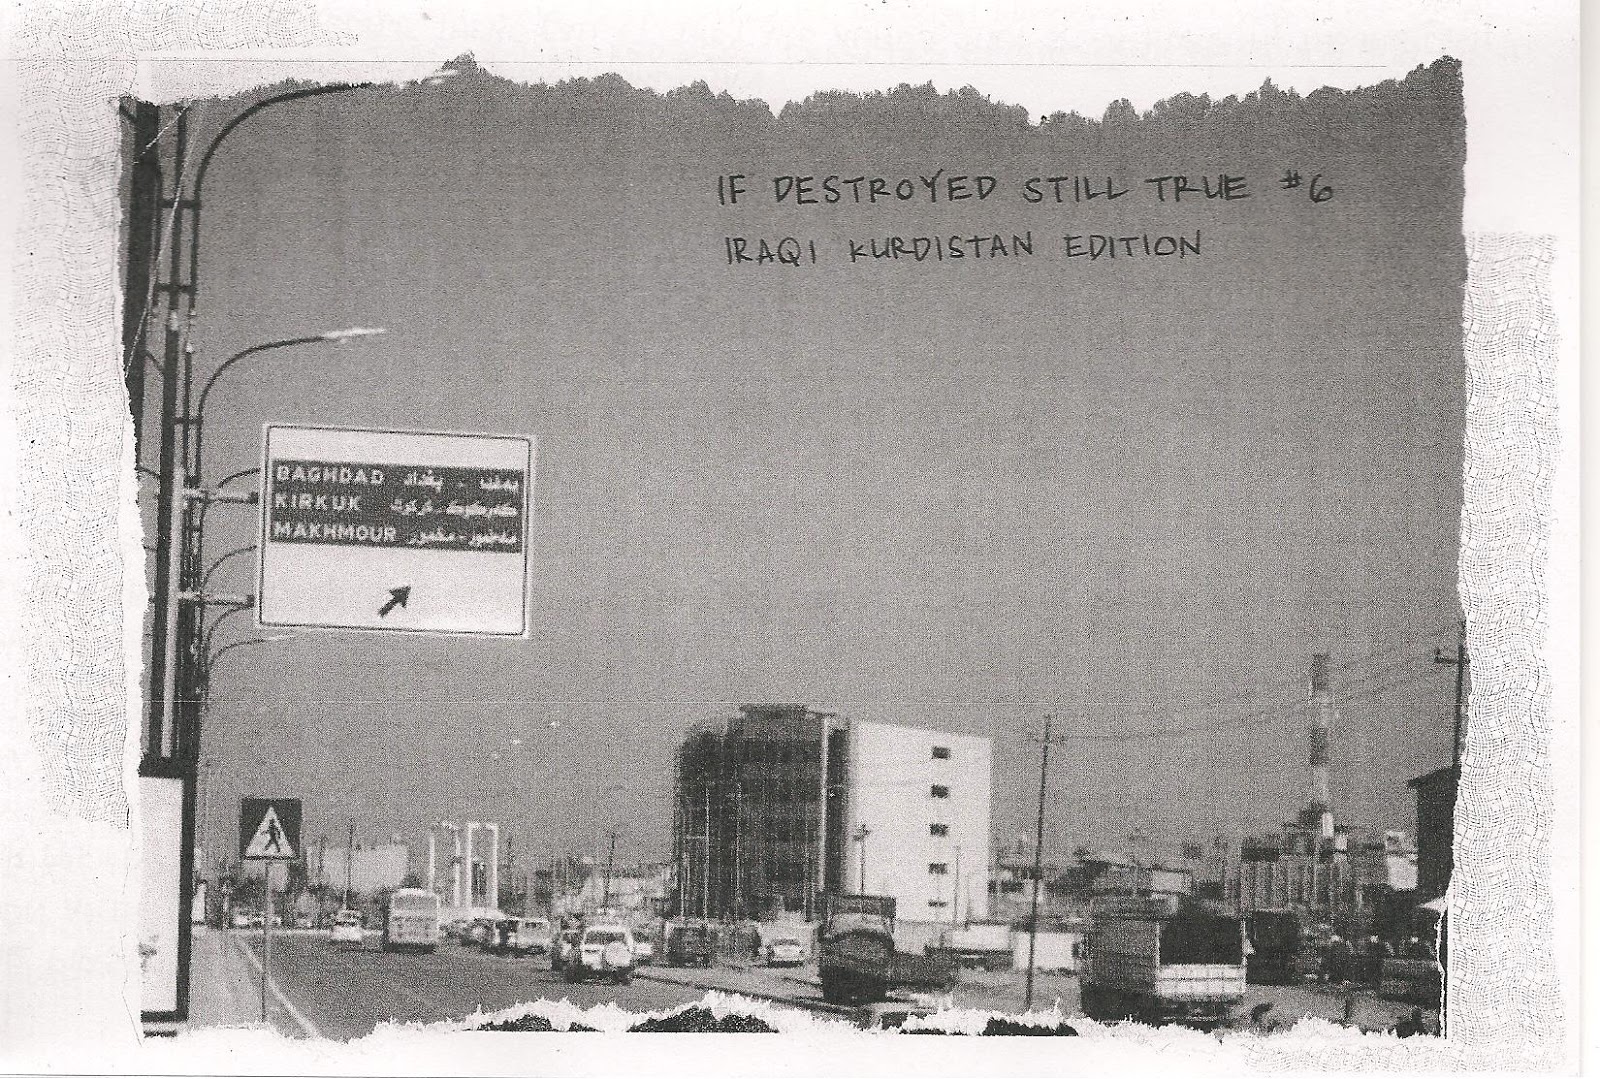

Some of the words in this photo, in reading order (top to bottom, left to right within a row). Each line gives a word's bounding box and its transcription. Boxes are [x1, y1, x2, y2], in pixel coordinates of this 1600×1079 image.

[717, 174, 746, 205] IF
[772, 168, 997, 204] DESTROYED
[1022, 175, 1129, 203] STILL
[1143, 174, 1250, 202] TRUE
[724, 236, 817, 267] IRAQI
[848, 231, 1033, 263] KURDISTAN
[1063, 229, 1201, 260] EDITION
[276, 465, 384, 485] BAGHDAD
[275, 492, 361, 512] KIRKUK
[273, 520, 397, 542] MAKHMOUR
